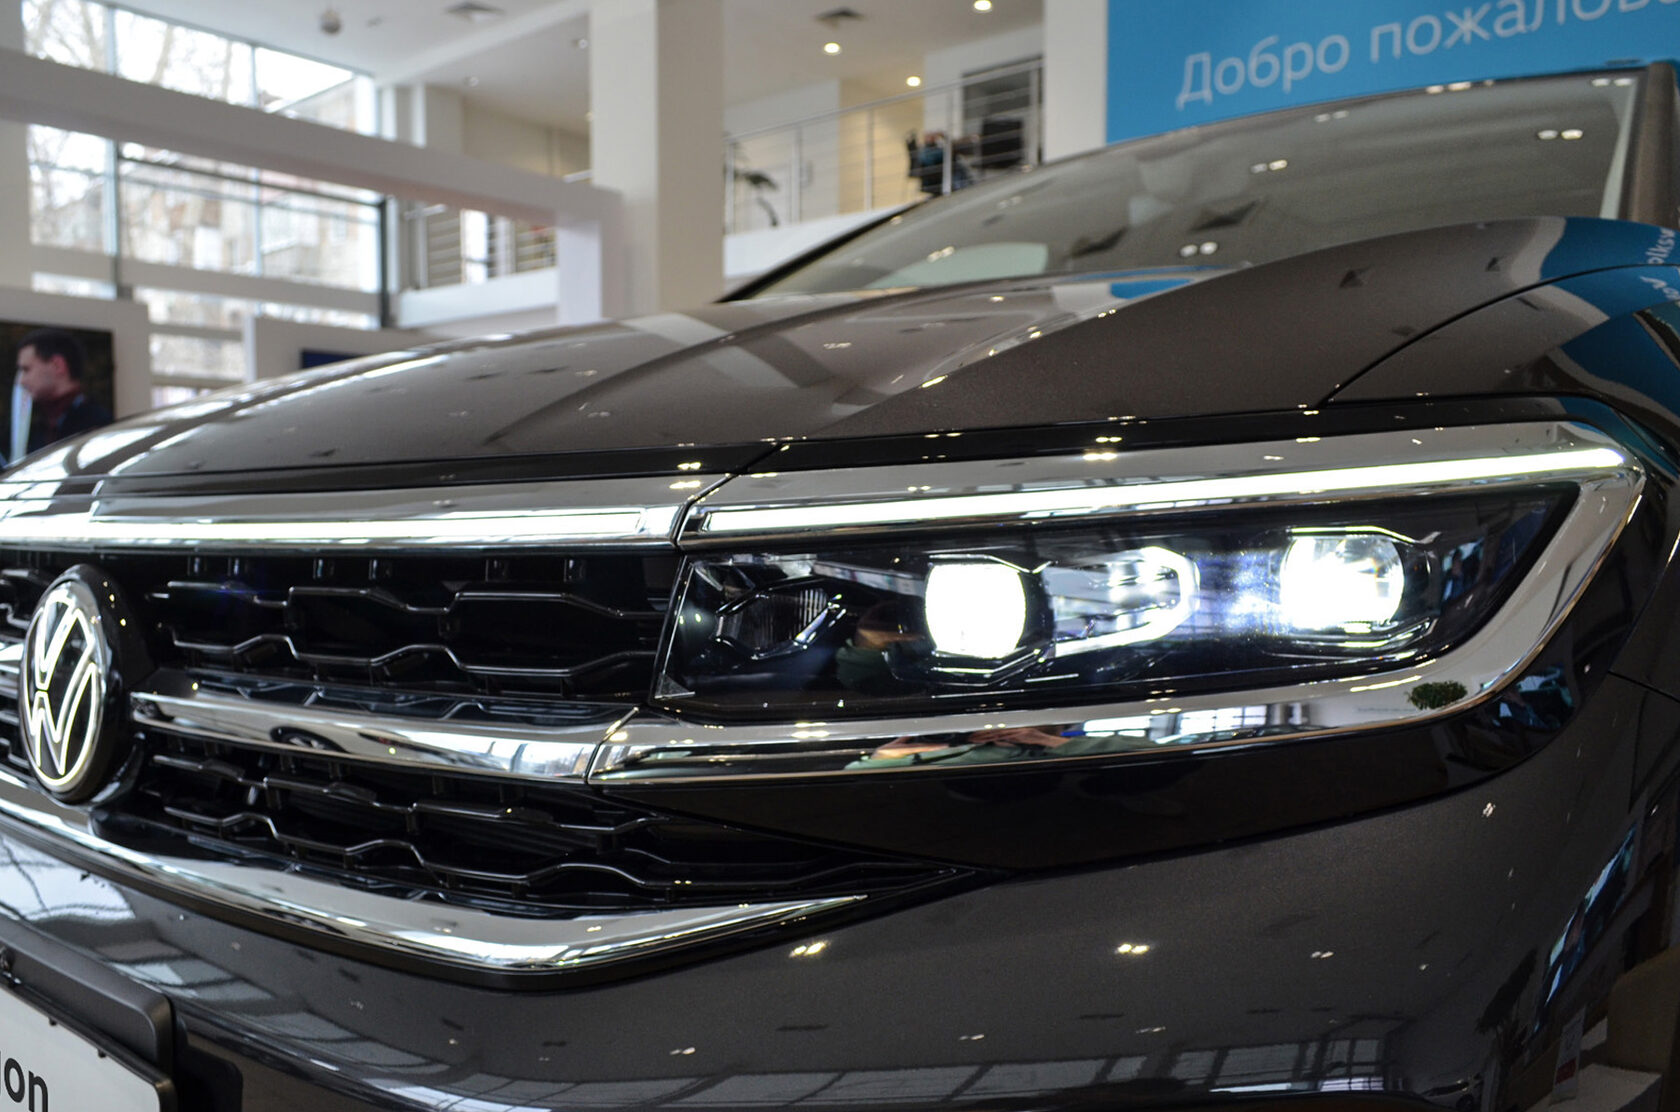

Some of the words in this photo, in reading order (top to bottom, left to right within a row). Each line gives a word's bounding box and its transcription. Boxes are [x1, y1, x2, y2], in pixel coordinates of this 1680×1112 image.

[1176, 35, 1350, 110] Добро
[1370, 0, 1680, 63] пожало
[0, 1050, 48, 1112] on
